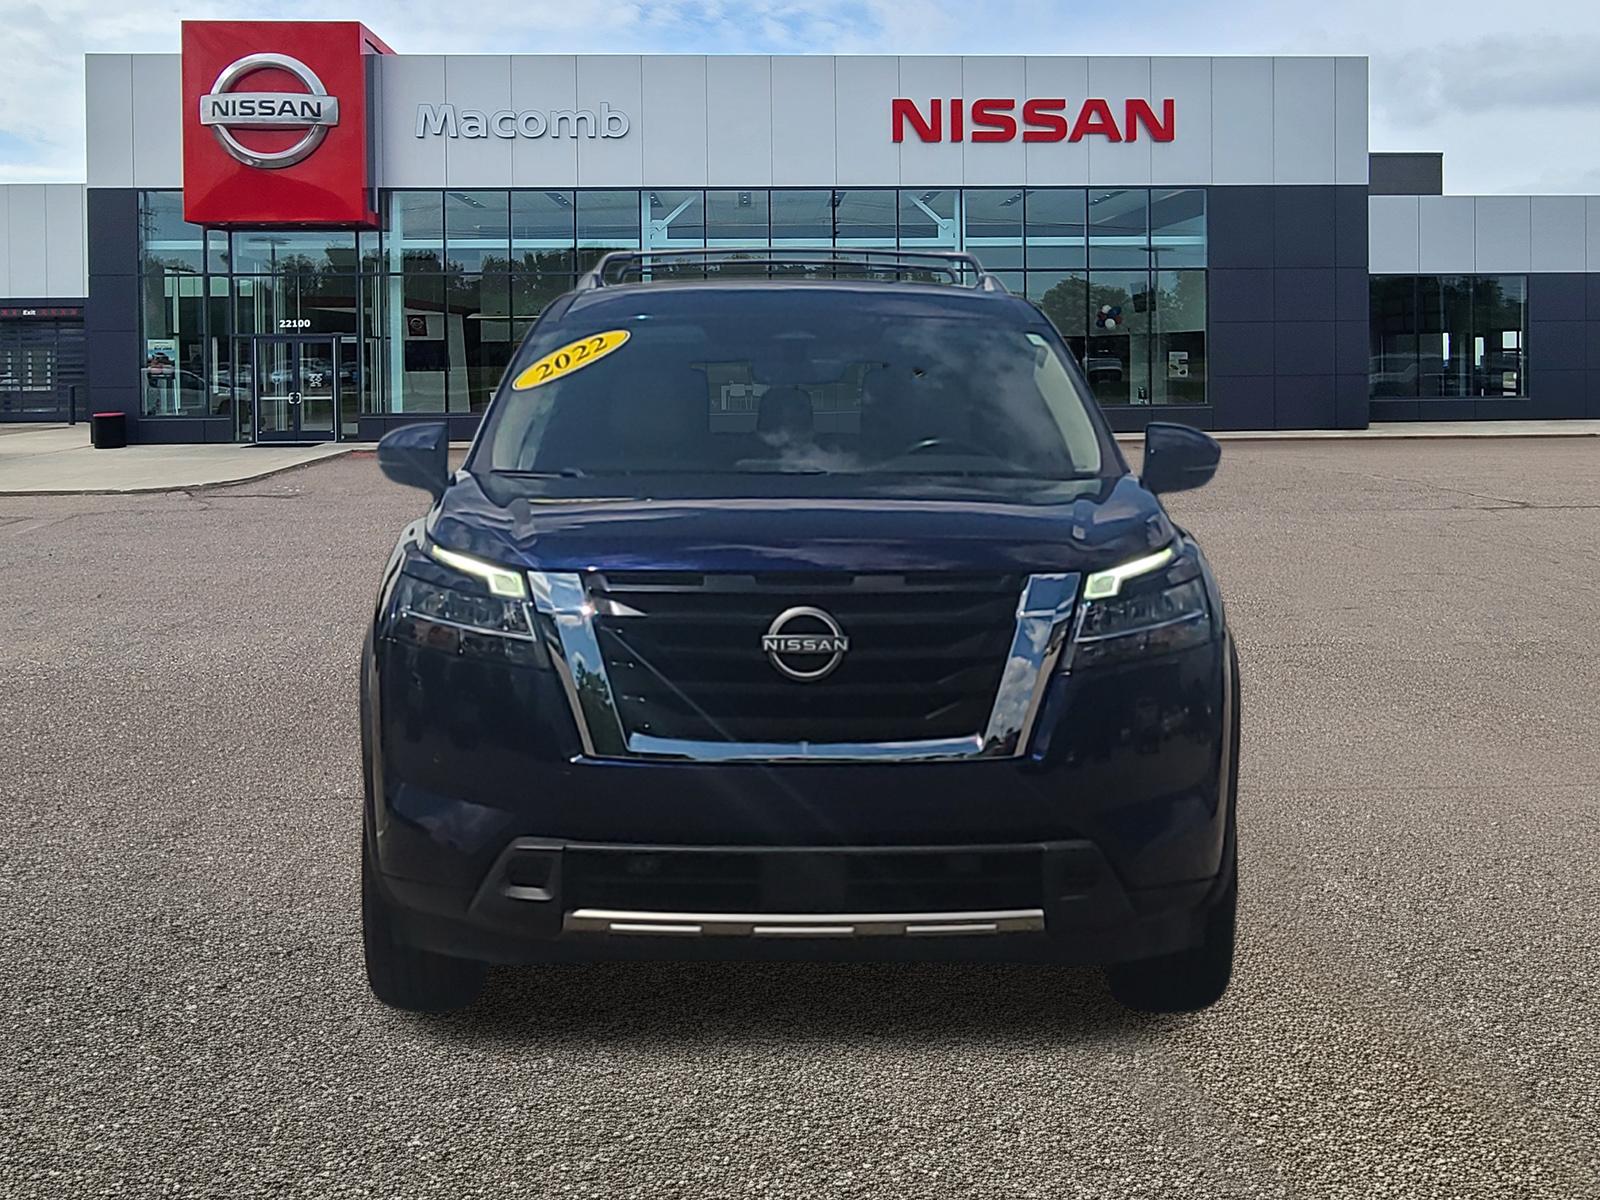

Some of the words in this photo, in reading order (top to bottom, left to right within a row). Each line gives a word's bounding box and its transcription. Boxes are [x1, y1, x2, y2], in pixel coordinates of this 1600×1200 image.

[212, 100, 322, 118] NISSAN
[415, 101, 630, 139] Macomb
[891, 98, 1175, 143] NISSAN
[279, 319, 311, 328] 22100
[535, 337, 608, 381] 2022
[763, 639, 848, 651] NISSAN
